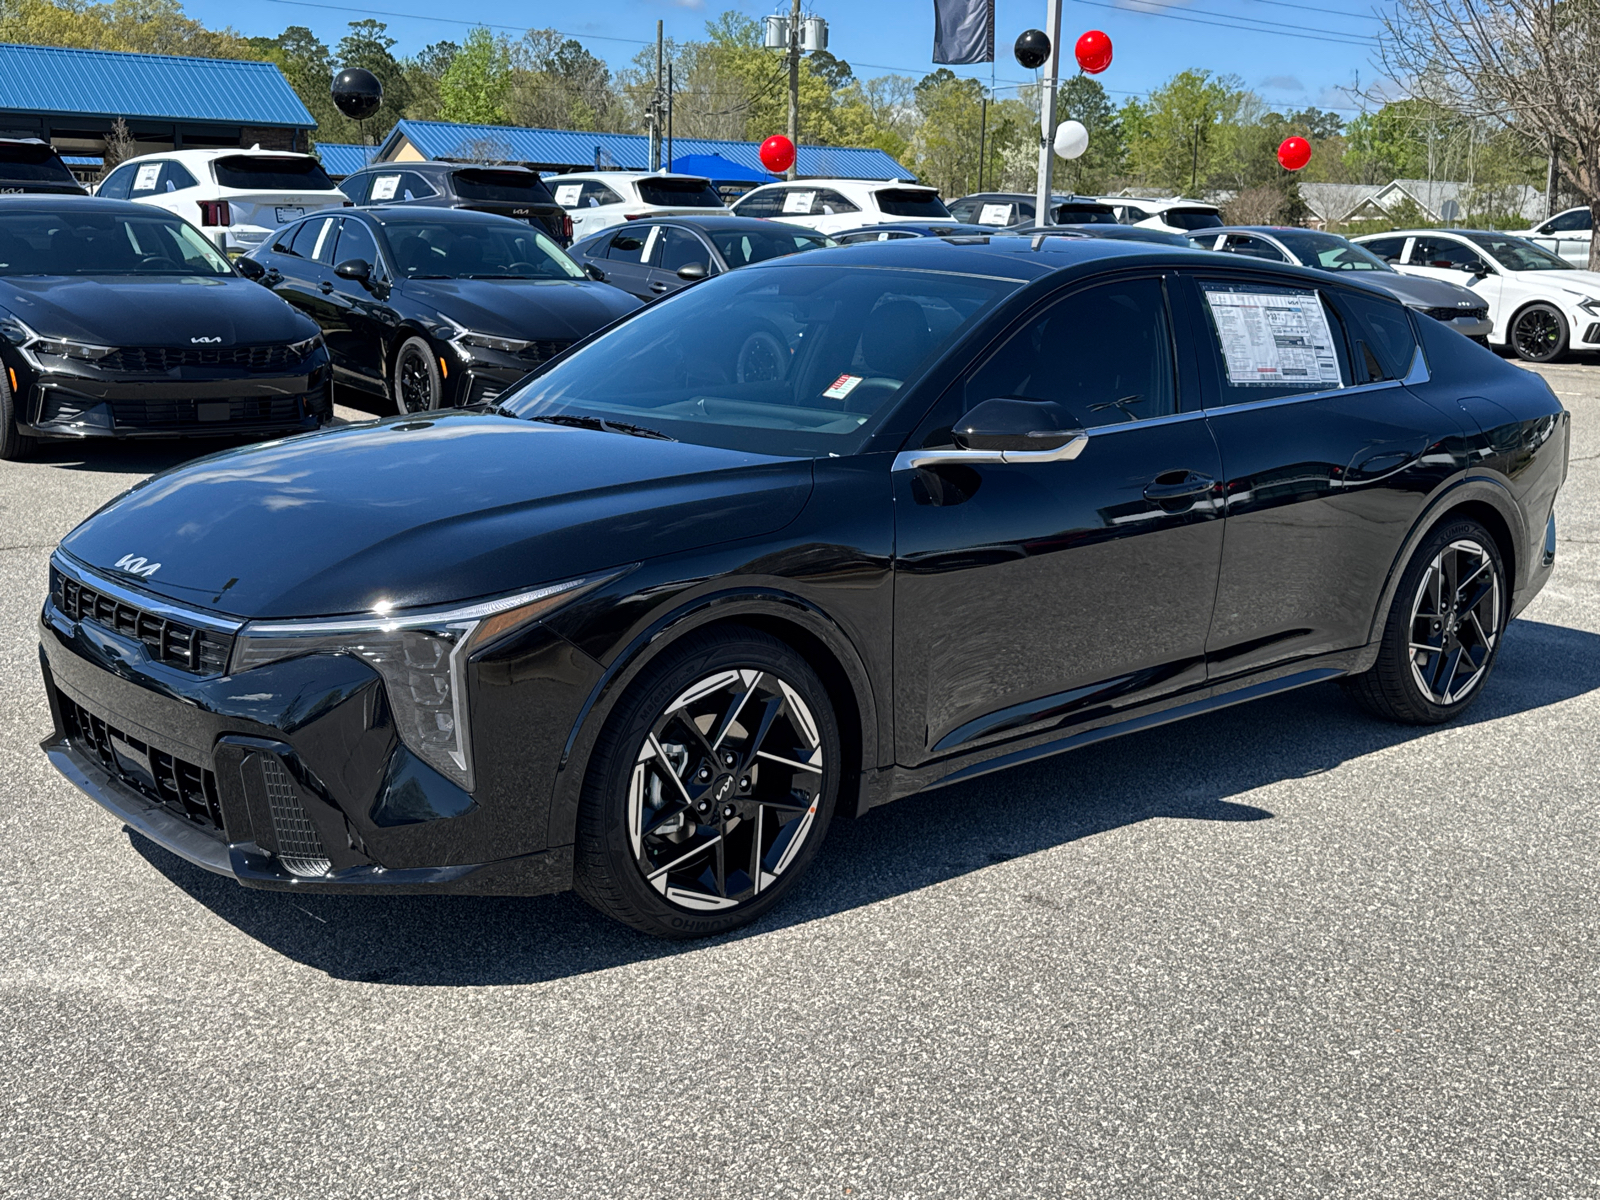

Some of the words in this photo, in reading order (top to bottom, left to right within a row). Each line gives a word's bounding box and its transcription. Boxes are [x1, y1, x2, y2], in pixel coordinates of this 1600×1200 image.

[190, 336, 222, 344] KIA
[1440, 524, 1469, 542] KUMHO
[114, 553, 162, 578] KIA
[715, 775, 734, 801] KIA
[671, 917, 734, 932] KUMHO
